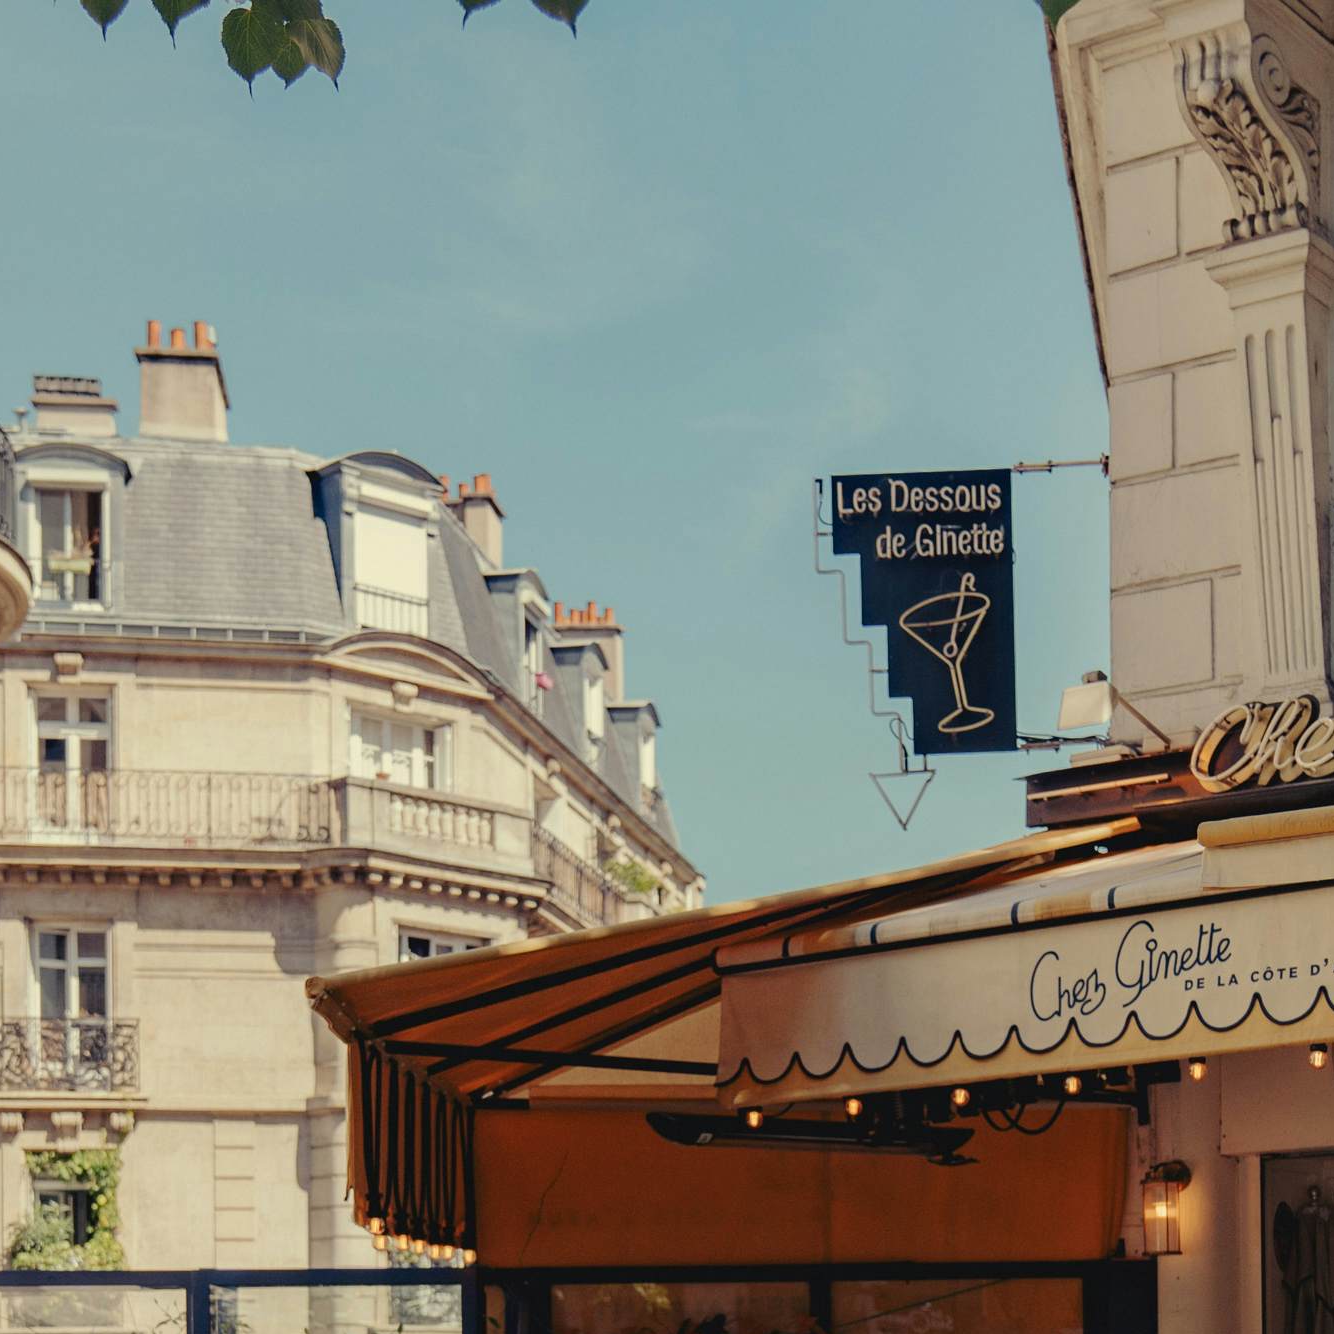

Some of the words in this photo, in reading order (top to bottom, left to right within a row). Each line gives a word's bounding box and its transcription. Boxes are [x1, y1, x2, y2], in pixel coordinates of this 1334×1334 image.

[837, 481, 882, 516] Les
[888, 478, 1002, 512] Dessous
[876, 525, 906, 559] de
[916, 522, 1005, 557] Ginette
[1030, 951, 1107, 1021] Chez
[1115, 920, 1233, 1008] Ginette
[1184, 978, 1206, 992] DE
[1217, 973, 1239, 987] LA
[1250, 965, 1299, 984] CÔTE
